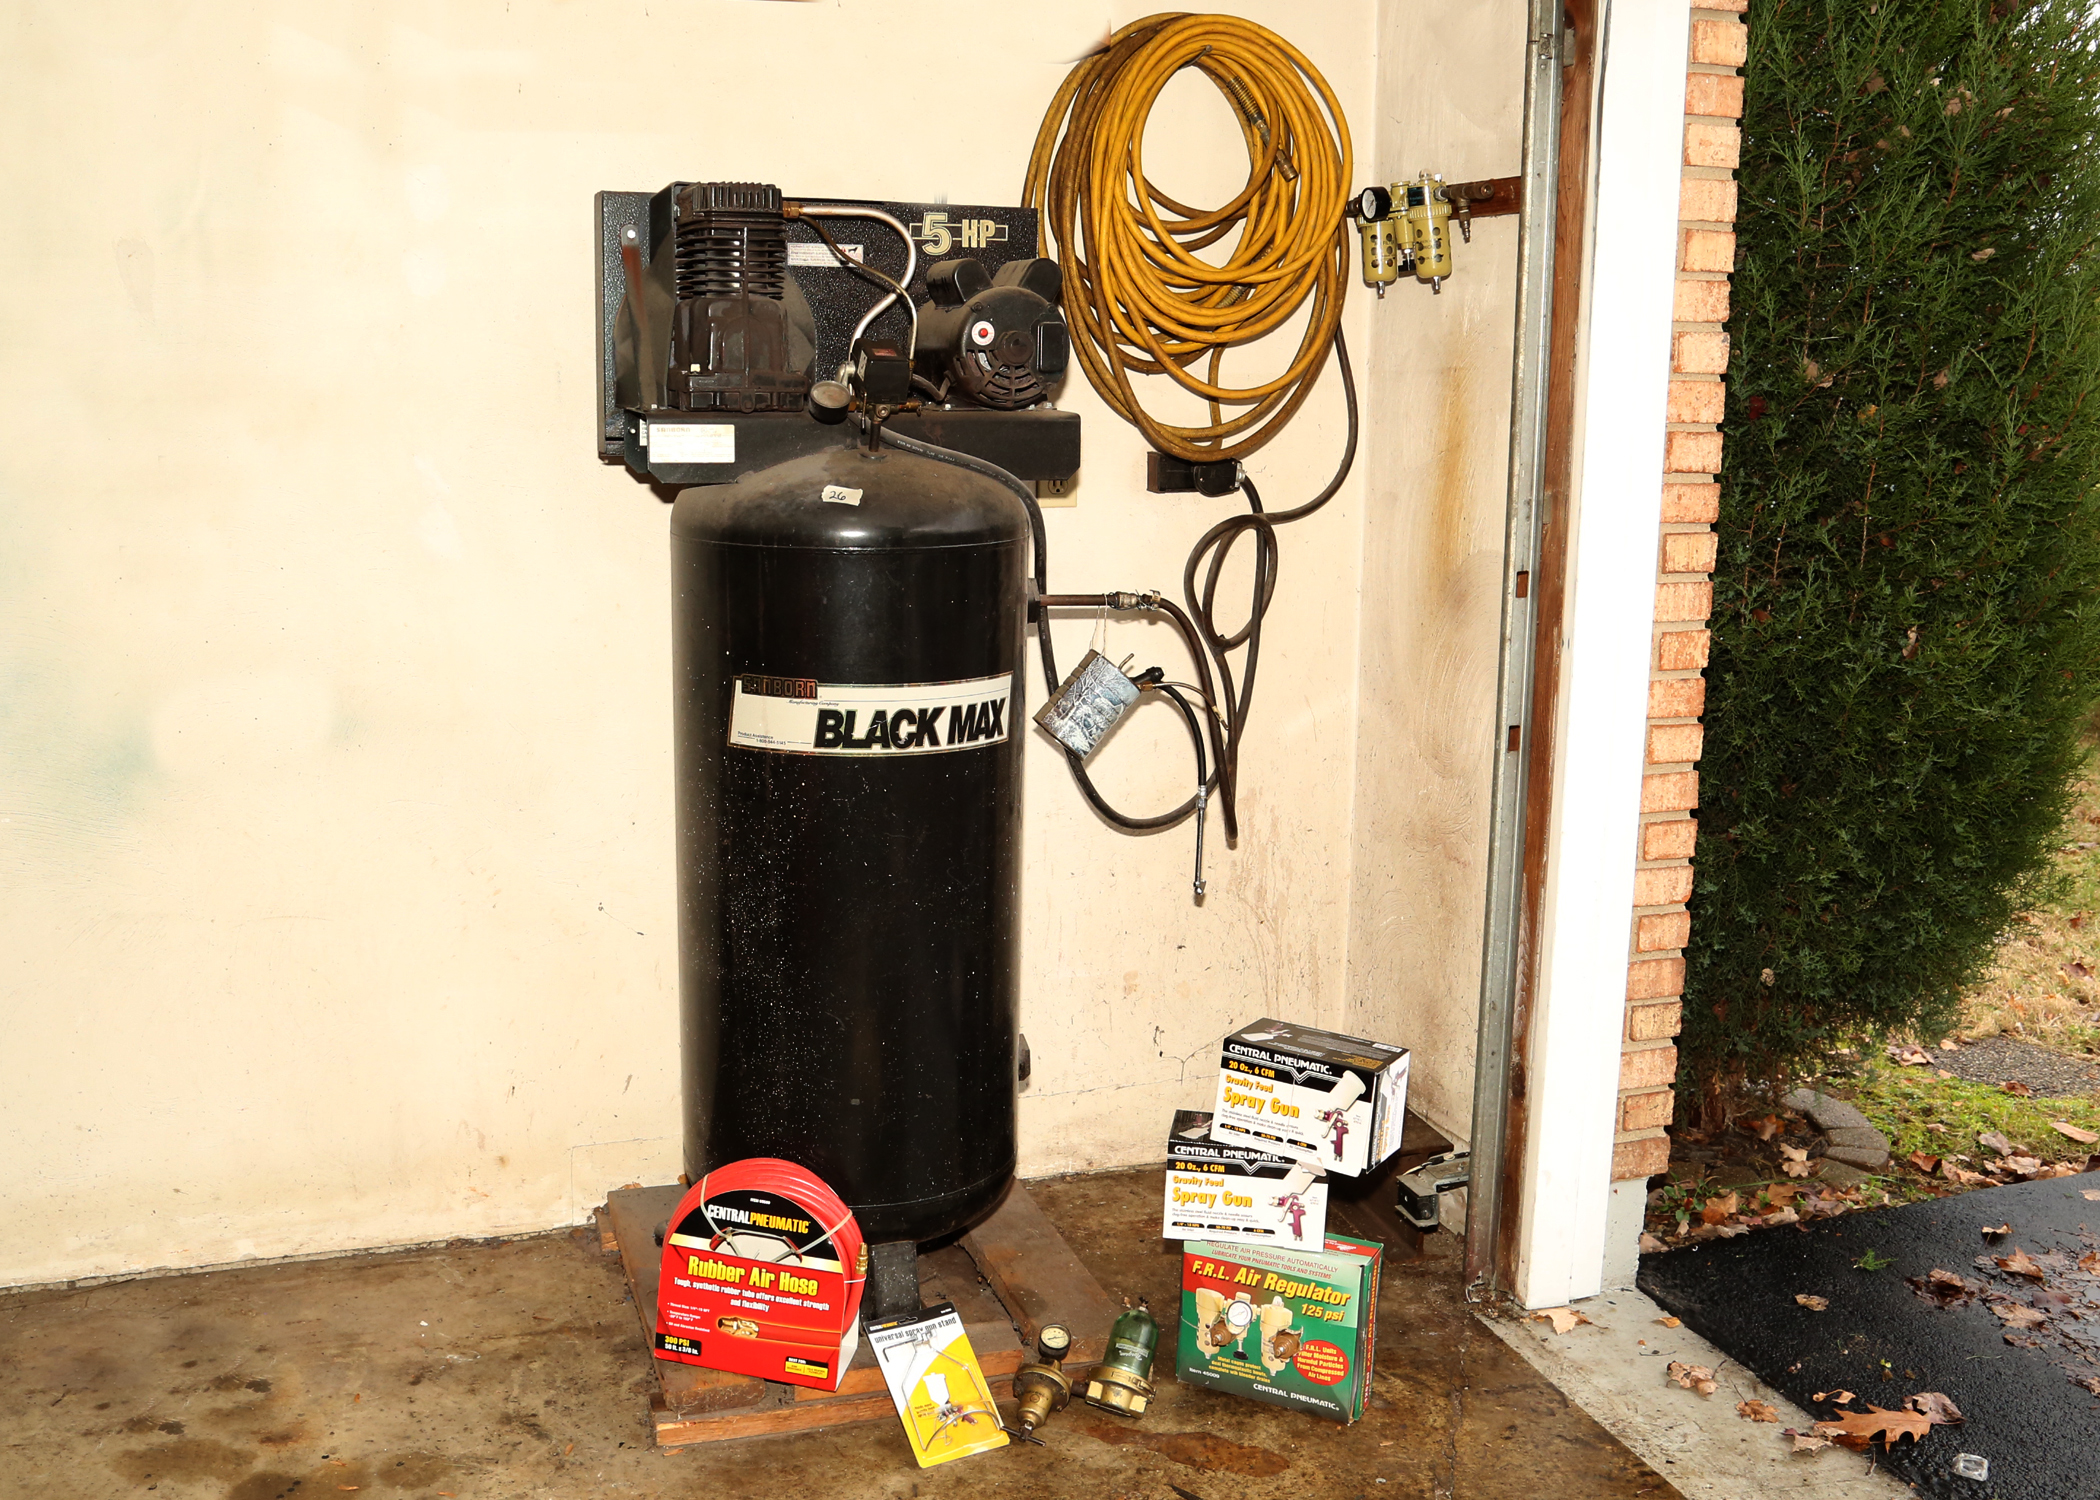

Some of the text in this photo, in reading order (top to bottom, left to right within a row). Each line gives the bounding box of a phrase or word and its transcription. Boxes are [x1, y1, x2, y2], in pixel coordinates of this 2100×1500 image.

[922, 212, 996, 255] 5 HP
[829, 490, 846, 500] 26
[743, 676, 816, 698] SANBORN
[813, 696, 1008, 749] BLACK MAX
[1229, 1043, 1272, 1061] CENTRAL
[1229, 1060, 1238, 1069] 20
[1261, 1068, 1275, 1078] CFM
[1226, 1074, 1273, 1093] Gravity Feed
[1223, 1086, 1300, 1118] Spray Gun
[1174, 1145, 1220, 1157] CENTRAL
[1176, 1162, 1185, 1170] 20
[1210, 1164, 1225, 1173] CFM
[1173, 1175, 1224, 1187] Gravity Feed
[1172, 1186, 1253, 1208] Spray Gun
[1207, 1241, 1239, 1252] REGULATE
[1252, 1250, 1285, 1262] PRESSURE
[1287, 1257, 1338, 1273] AUTOMATICALLY
[1212, 1249, 1237, 1259] LUBRICATE
[1252, 1258, 1280, 1269] PNEUMATIC
[1281, 1264, 1296, 1272] TOOLS
[1297, 1267, 1308, 1275] AND
[1309, 1270, 1332, 1279] SYSTEMS
[688, 1255, 818, 1296] Rubber Air Hose
[1192, 1260, 1230, 1281] F.R.L.
[1233, 1267, 1261, 1287] Air
[1263, 1272, 1351, 1306] Regulator
[674, 1277, 830, 1311] Tough, synthetic rubber tube offers excellent strength
[730, 1299, 770, 1312] and flexibility
[1301, 1303, 1345, 1322] 125 psi
[874, 1330, 904, 1344] universal
[905, 1327, 923, 1336] spray
[938, 1317, 957, 1328] stand
[665, 1335, 690, 1346] 300 PSI
[1306, 1344, 1321, 1352] F.R.L.
[1298, 1357, 1344, 1369] Harmful Particles
[1314, 1353, 1338, 1361] Moisture
[1311, 1366, 1344, 1376] Compressed
[1253, 1383, 1288, 1397] CENTRAL
